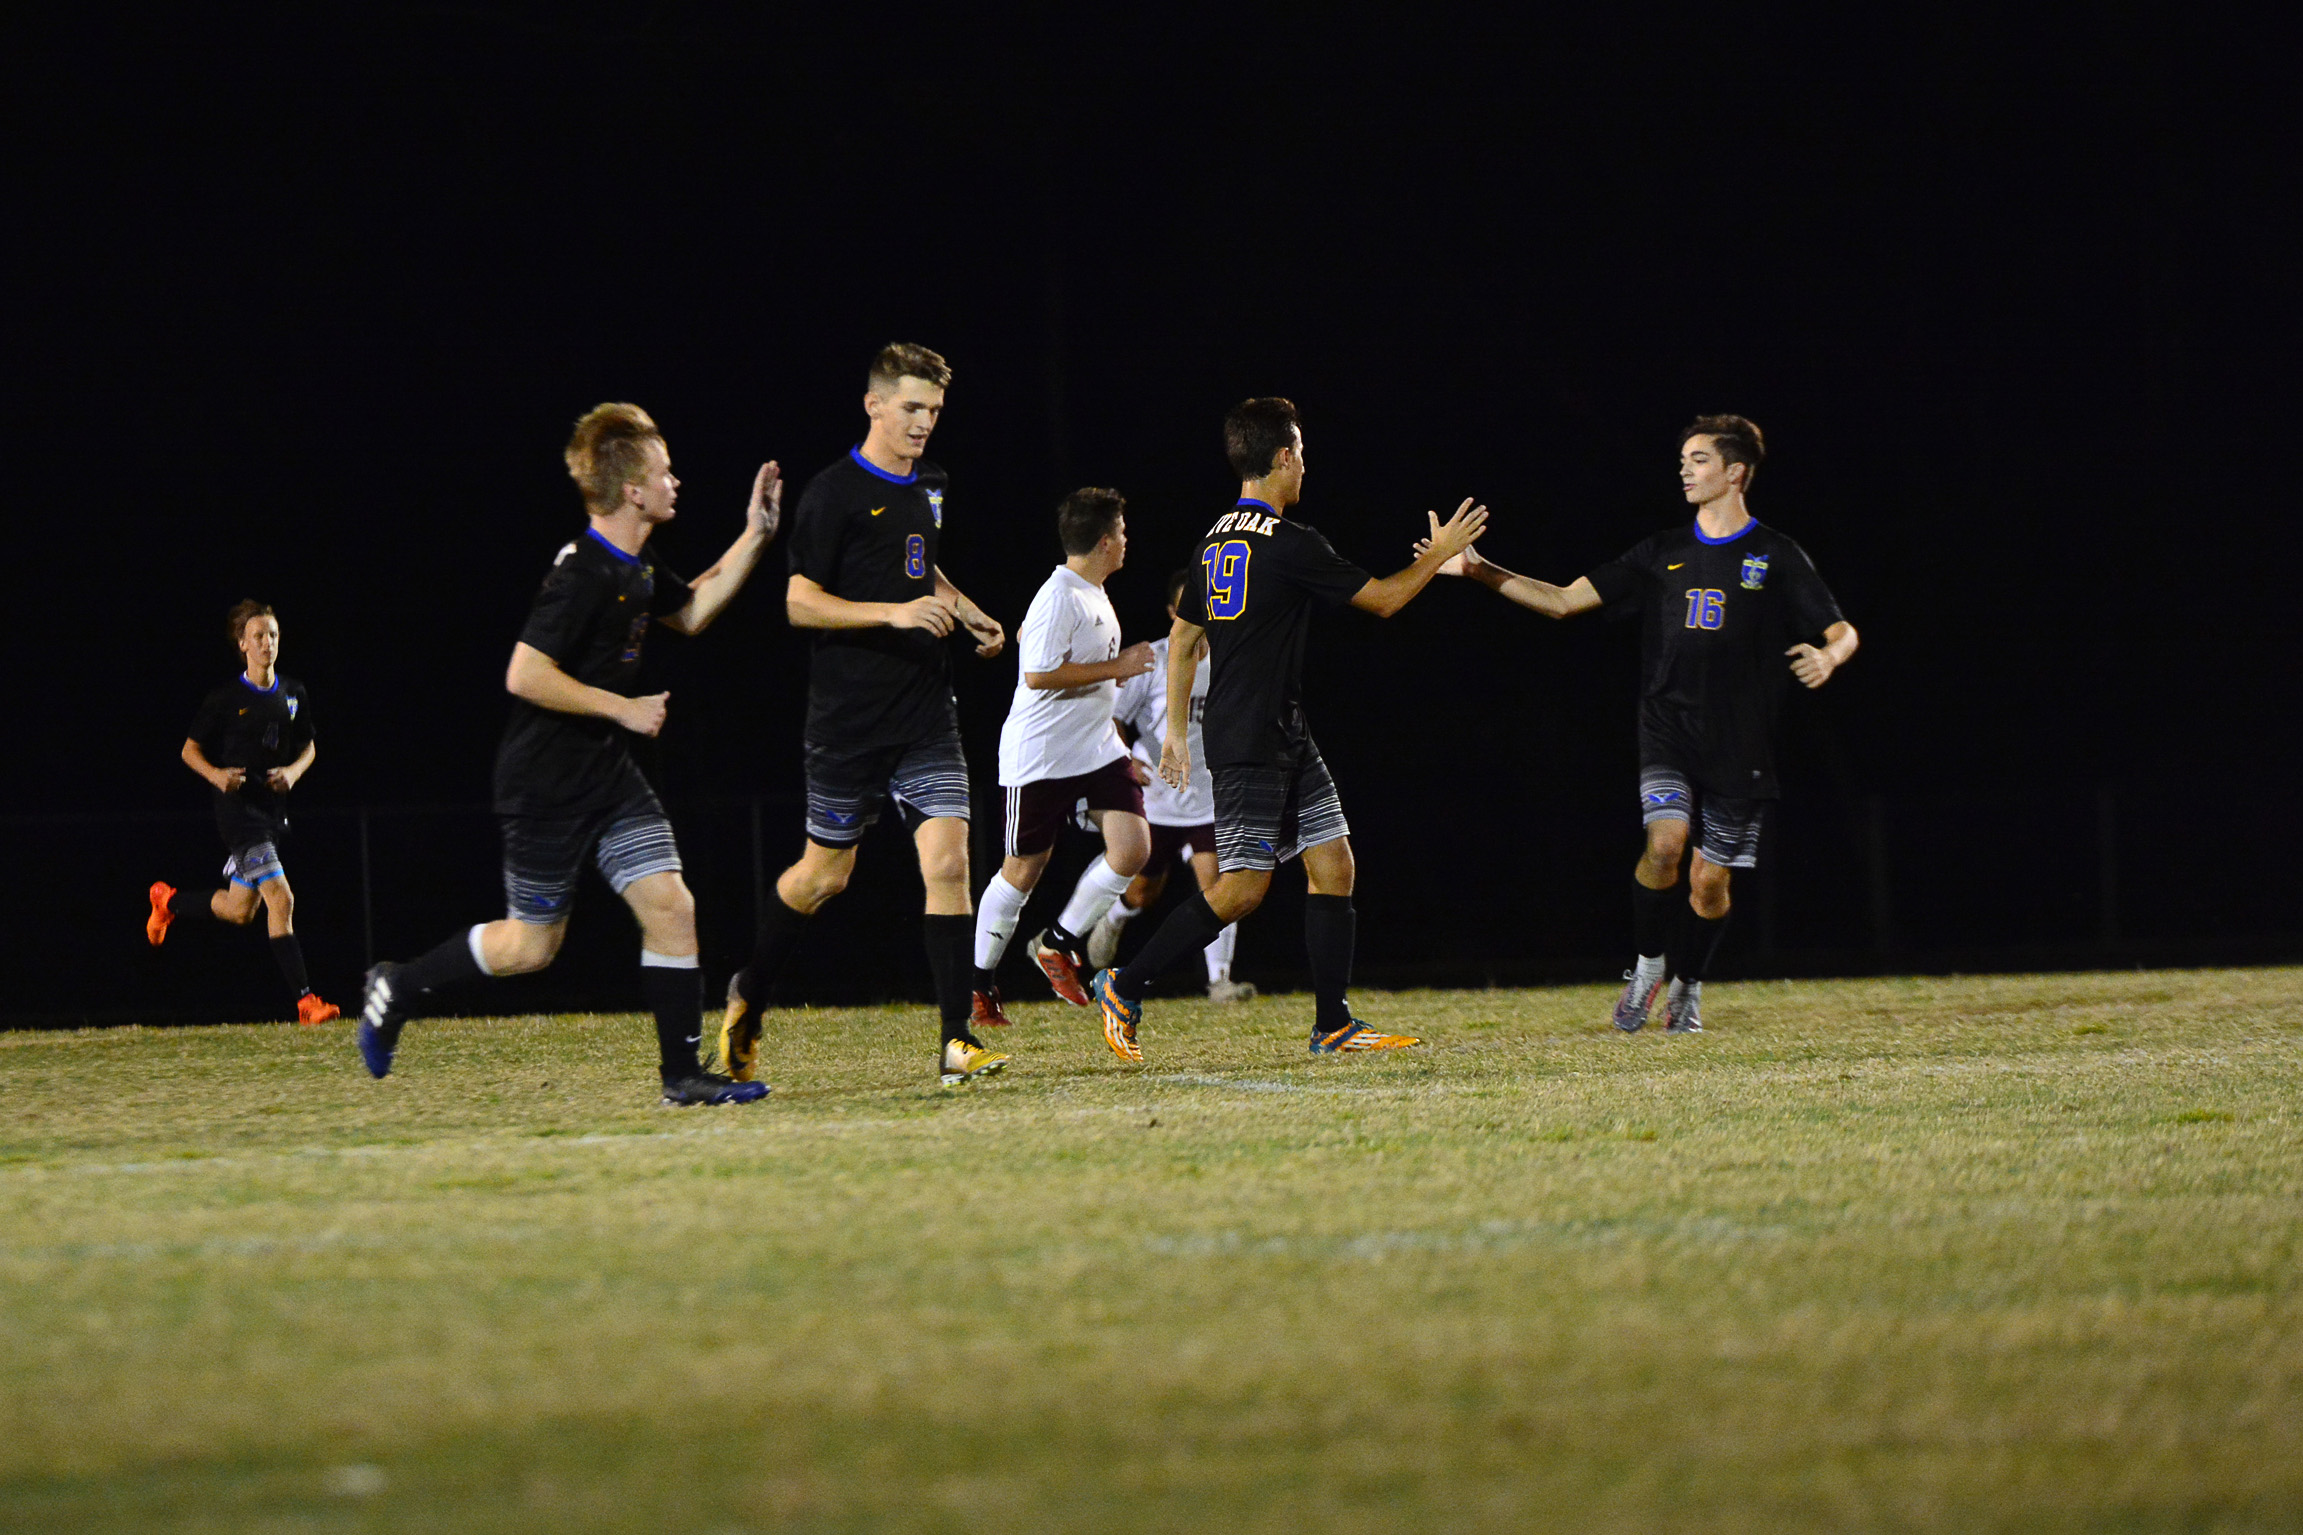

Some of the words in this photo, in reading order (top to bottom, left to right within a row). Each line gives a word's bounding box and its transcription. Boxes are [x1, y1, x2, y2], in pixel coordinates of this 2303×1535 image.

[1234, 511, 1281, 537] OAK
[905, 533, 925, 579] 8
[1202, 539, 1251, 621] 19
[1684, 588, 1726, 630] 16
